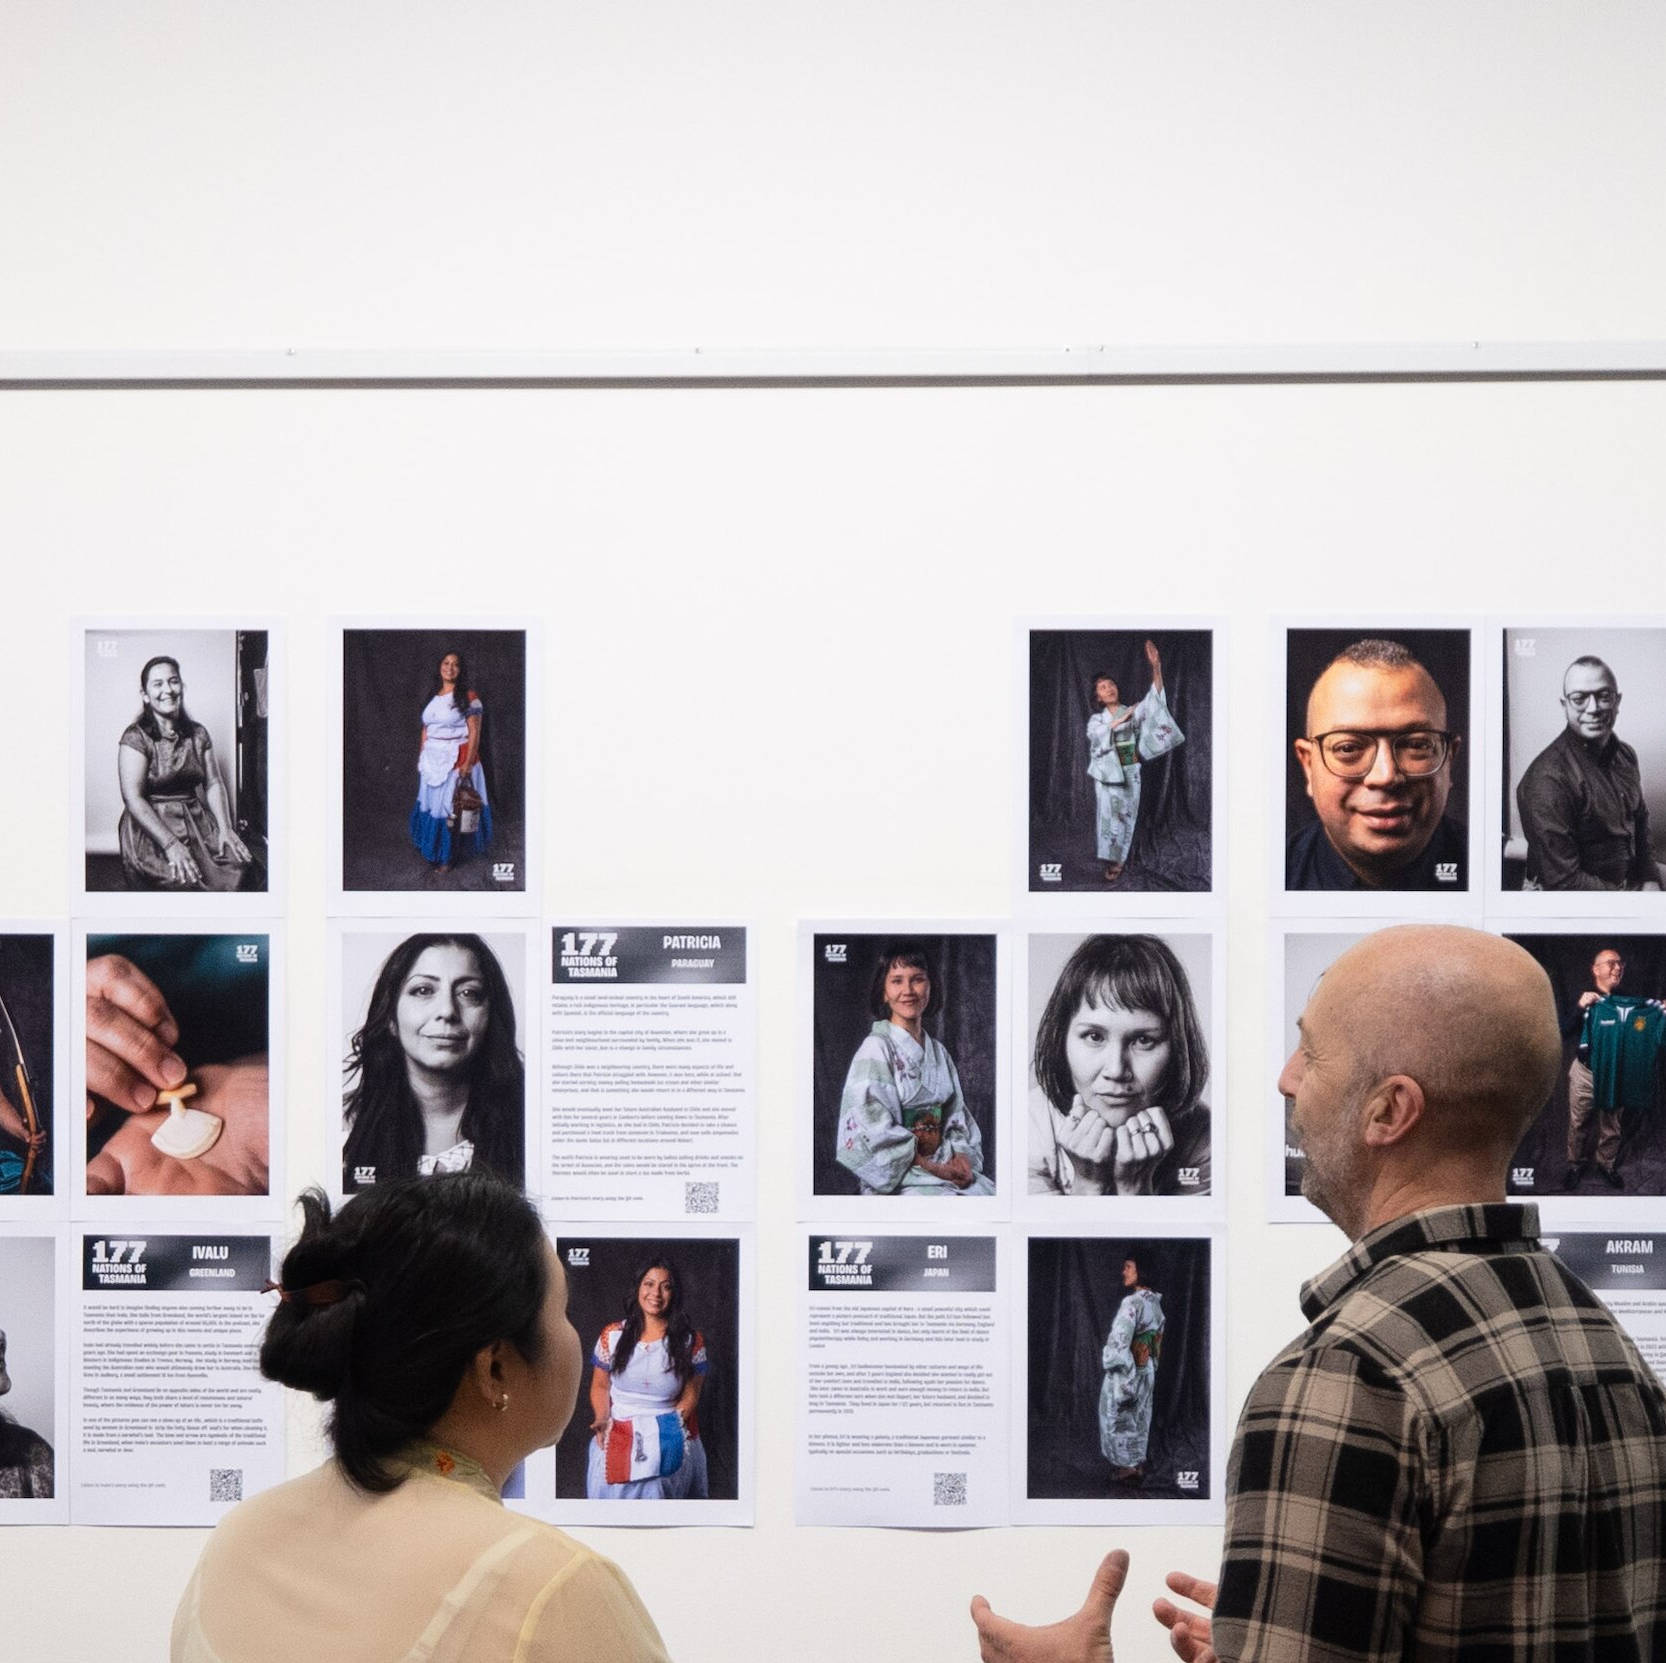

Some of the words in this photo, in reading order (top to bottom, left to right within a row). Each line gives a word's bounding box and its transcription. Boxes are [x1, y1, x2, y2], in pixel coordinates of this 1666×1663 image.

[493, 863, 514, 872] 177
[1041, 864, 1062, 873] 177
[1436, 863, 1457, 872] 177
[561, 932, 619, 956] 177
[663, 935, 721, 949] PATRICIA
[237, 945, 258, 954] 177
[825, 944, 847, 954] 177
[561, 956, 603, 967] NATIONS
[605, 956, 618, 966] OF
[671, 958, 715, 968] PARAGUAY
[568, 967, 618, 978] TASMANIA
[354, 1167, 376, 1176] 177
[1178, 1168, 1200, 1177] 177
[1513, 1168, 1534, 1177] 177
[92, 1241, 147, 1263] 177
[927, 1245, 948, 1259] ERI
[1606, 1240, 1654, 1254] AKRAM
[192, 1246, 229, 1260] IVALU
[568, 1248, 590, 1257] 177
[818, 1241, 873, 1264] 177
[92, 1263, 133, 1273] NATIONS
[134, 1263, 147, 1273] OF
[189, 1268, 236, 1278] GREENLAND
[818, 1264, 859, 1274] NATIONS
[860, 1264, 873, 1274] OF
[923, 1267, 949, 1277] JAPAN
[1611, 1264, 1645, 1274] TUNISIA
[99, 1273, 147, 1284] TASMANIA
[825, 1275, 873, 1285] TASMANIA
[1178, 1471, 1199, 1481] 177
